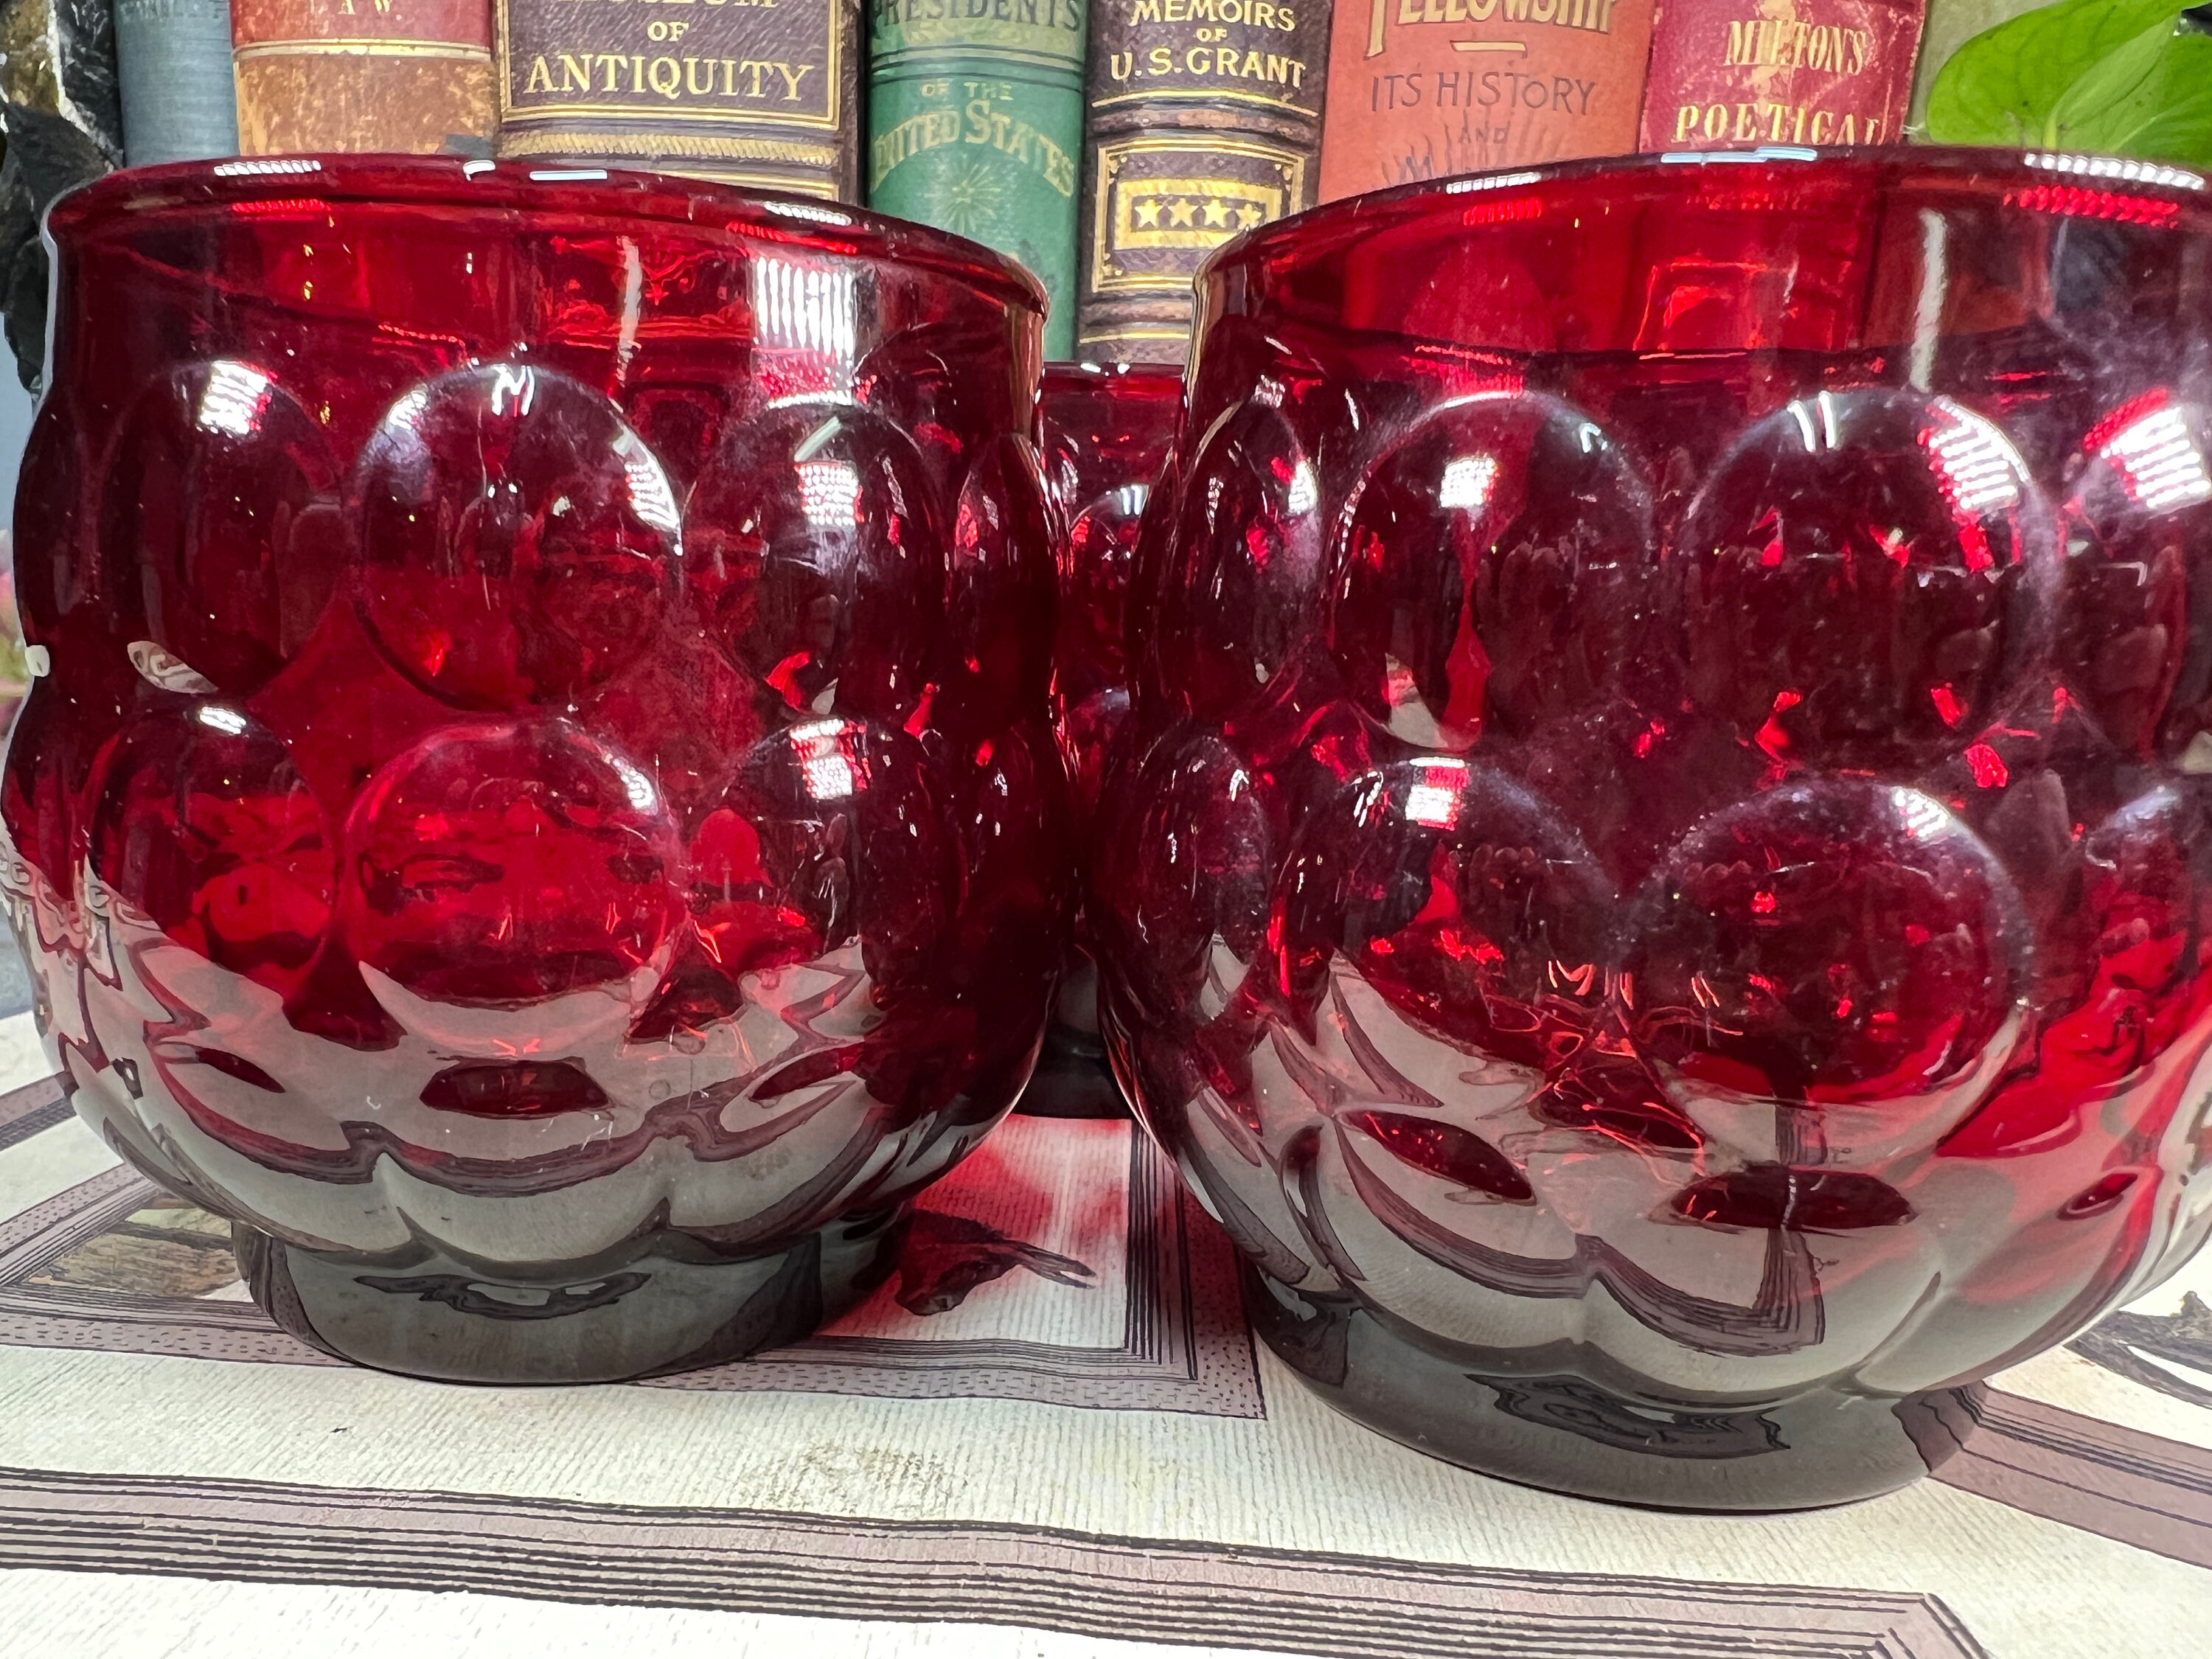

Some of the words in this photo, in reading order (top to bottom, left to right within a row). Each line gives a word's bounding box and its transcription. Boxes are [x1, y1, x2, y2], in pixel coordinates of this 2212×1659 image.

[1128, 0, 1295, 32] MEMOIRS
[647, 21, 689, 42] OF
[1195, 27, 1228, 42] OF
[523, 53, 815, 102] ANTIQUITY
[921, 82, 950, 97] OF
[963, 82, 1014, 101] THE
[1371, 74, 1422, 112] ITS
[1436, 72, 1596, 116] HISTORY
